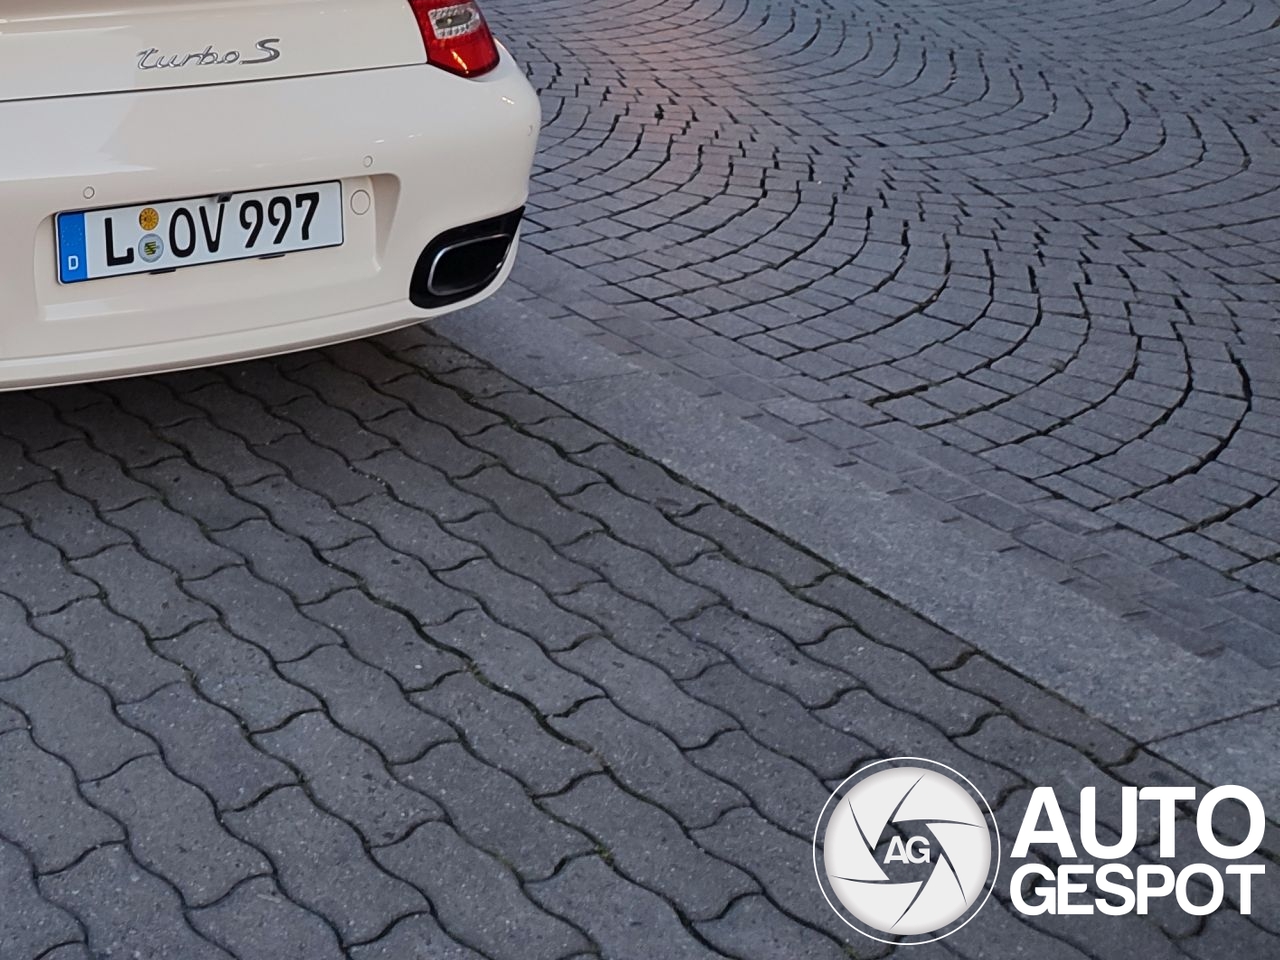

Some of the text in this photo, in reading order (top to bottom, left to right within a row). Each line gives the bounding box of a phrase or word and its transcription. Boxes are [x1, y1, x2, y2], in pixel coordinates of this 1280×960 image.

[239, 38, 280, 65] S
[104, 217, 134, 267] L
[169, 203, 225, 258] OV
[239, 192, 320, 249] 997
